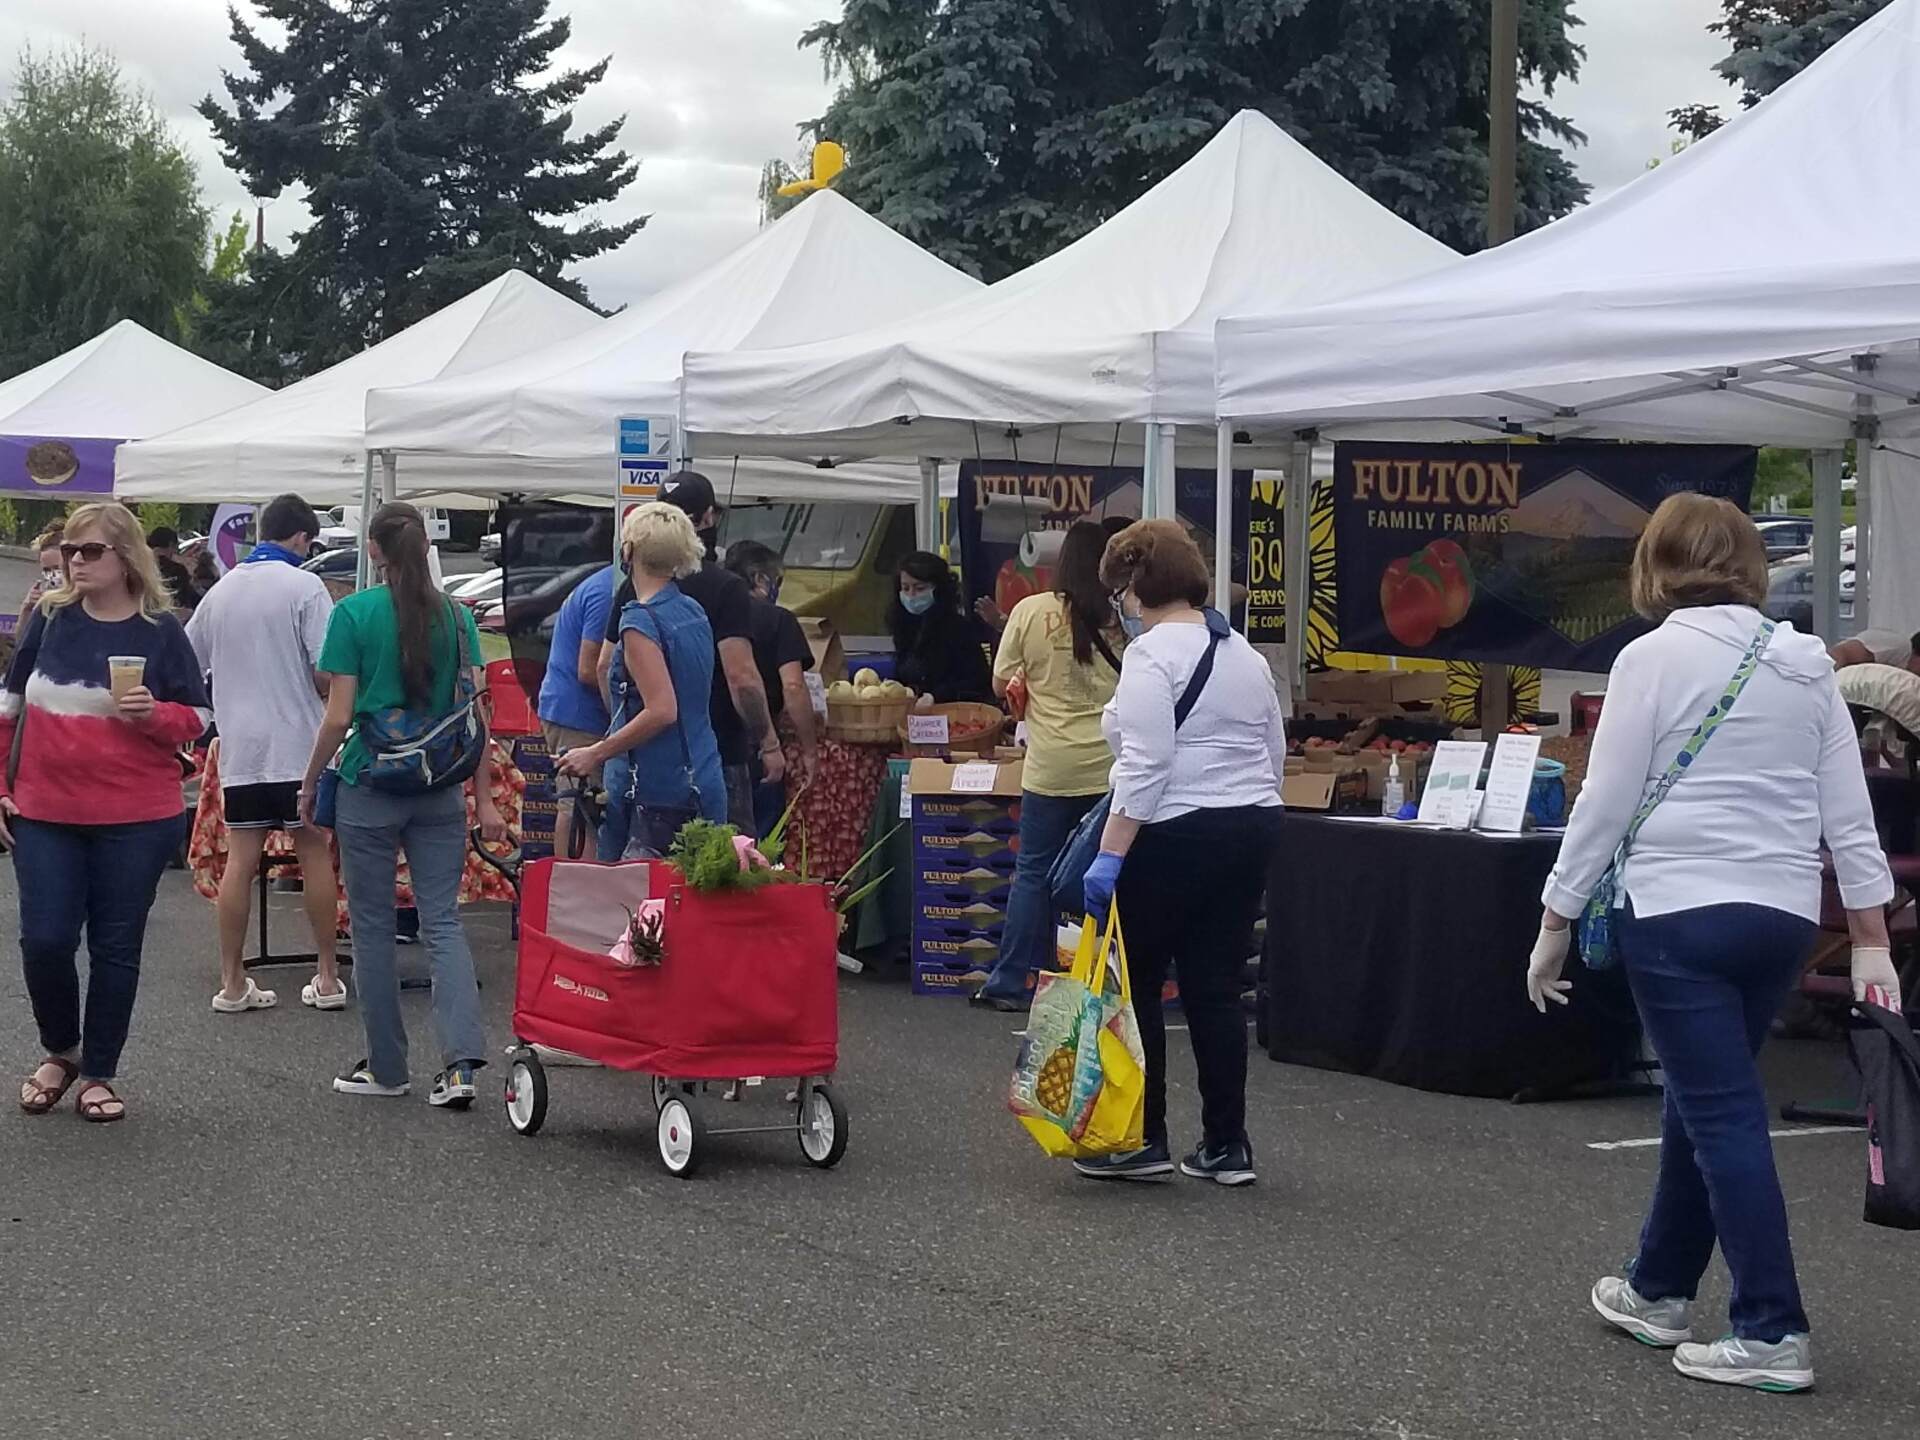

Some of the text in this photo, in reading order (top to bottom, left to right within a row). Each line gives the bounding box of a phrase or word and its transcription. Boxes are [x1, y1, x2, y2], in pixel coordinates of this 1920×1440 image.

[629, 471, 660, 485] VISA
[1352, 460, 1522, 507] FULTON
[1040, 520, 1074, 531] FARM
[1368, 510, 1510, 534] FAMILY FARMS
